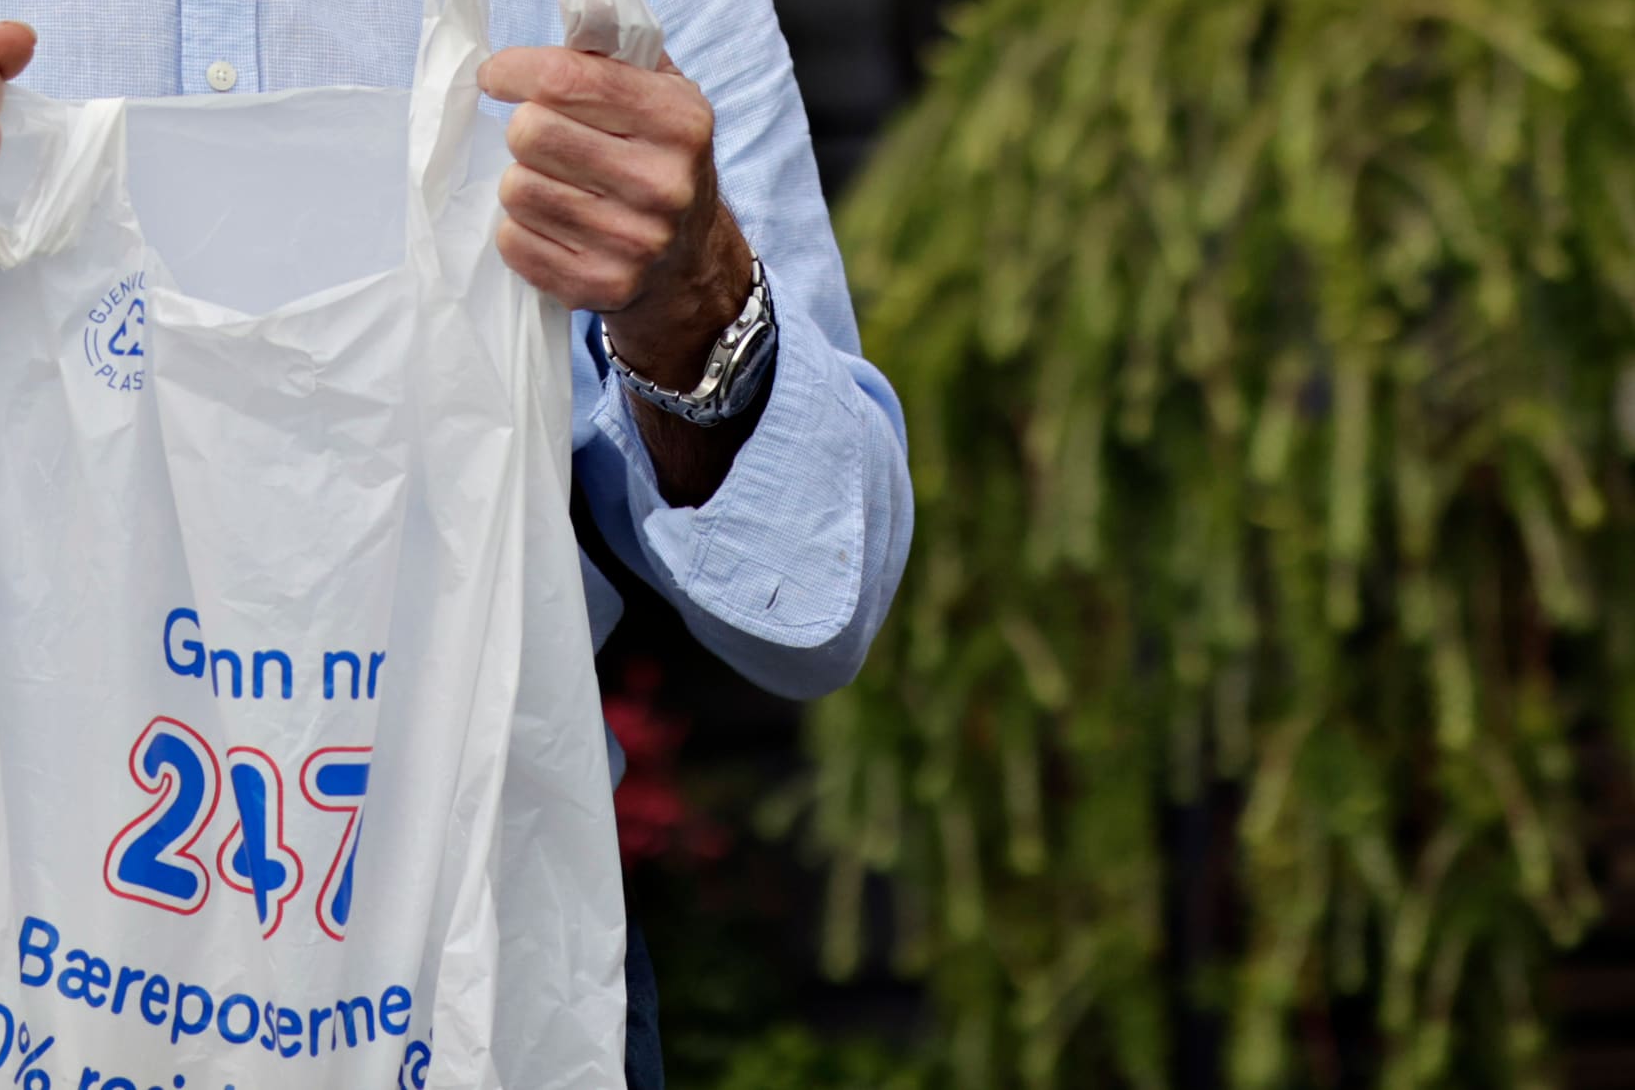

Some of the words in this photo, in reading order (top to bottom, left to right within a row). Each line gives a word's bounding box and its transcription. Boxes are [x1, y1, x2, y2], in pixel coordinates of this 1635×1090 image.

[94, 363, 146, 392] PLAS
[322, 649, 387, 700] nr
[102, 714, 374, 942] 247
